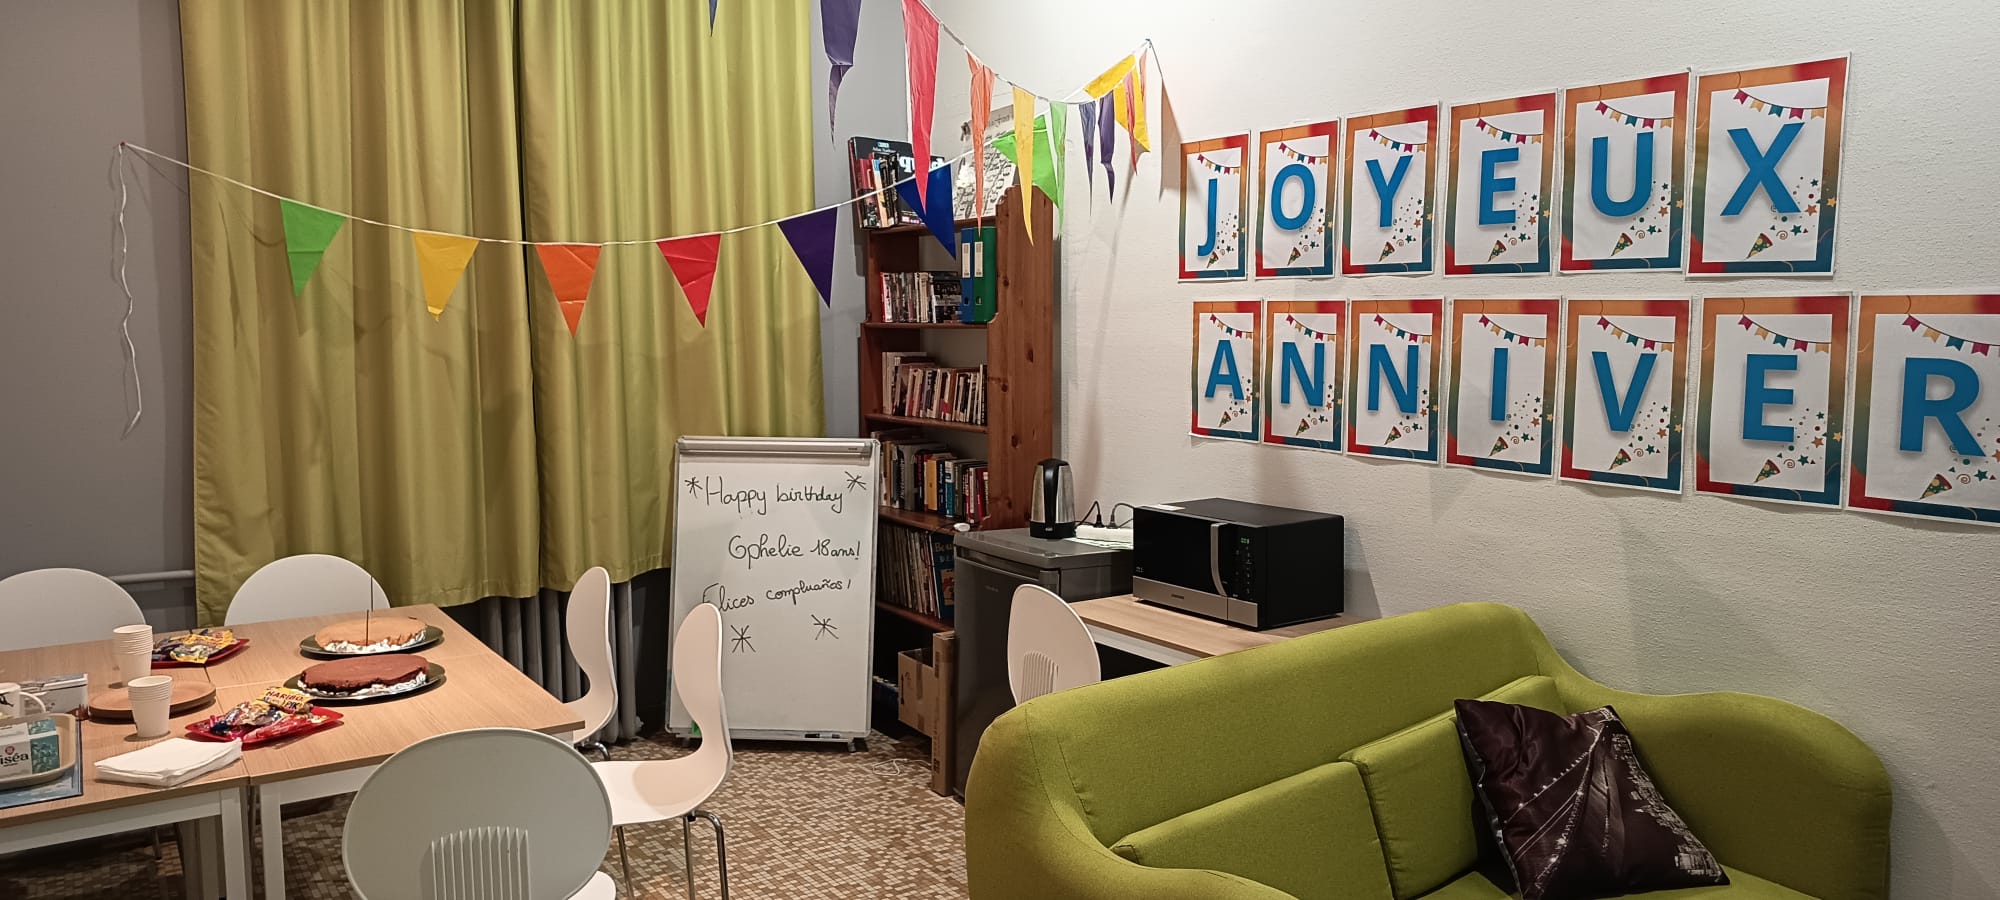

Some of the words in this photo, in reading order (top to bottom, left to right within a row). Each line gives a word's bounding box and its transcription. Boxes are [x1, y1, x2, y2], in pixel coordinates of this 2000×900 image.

[705, 475, 767, 515] Happy
[776, 484, 843, 514] birthday
[265, 690, 304, 702] HARIBO
